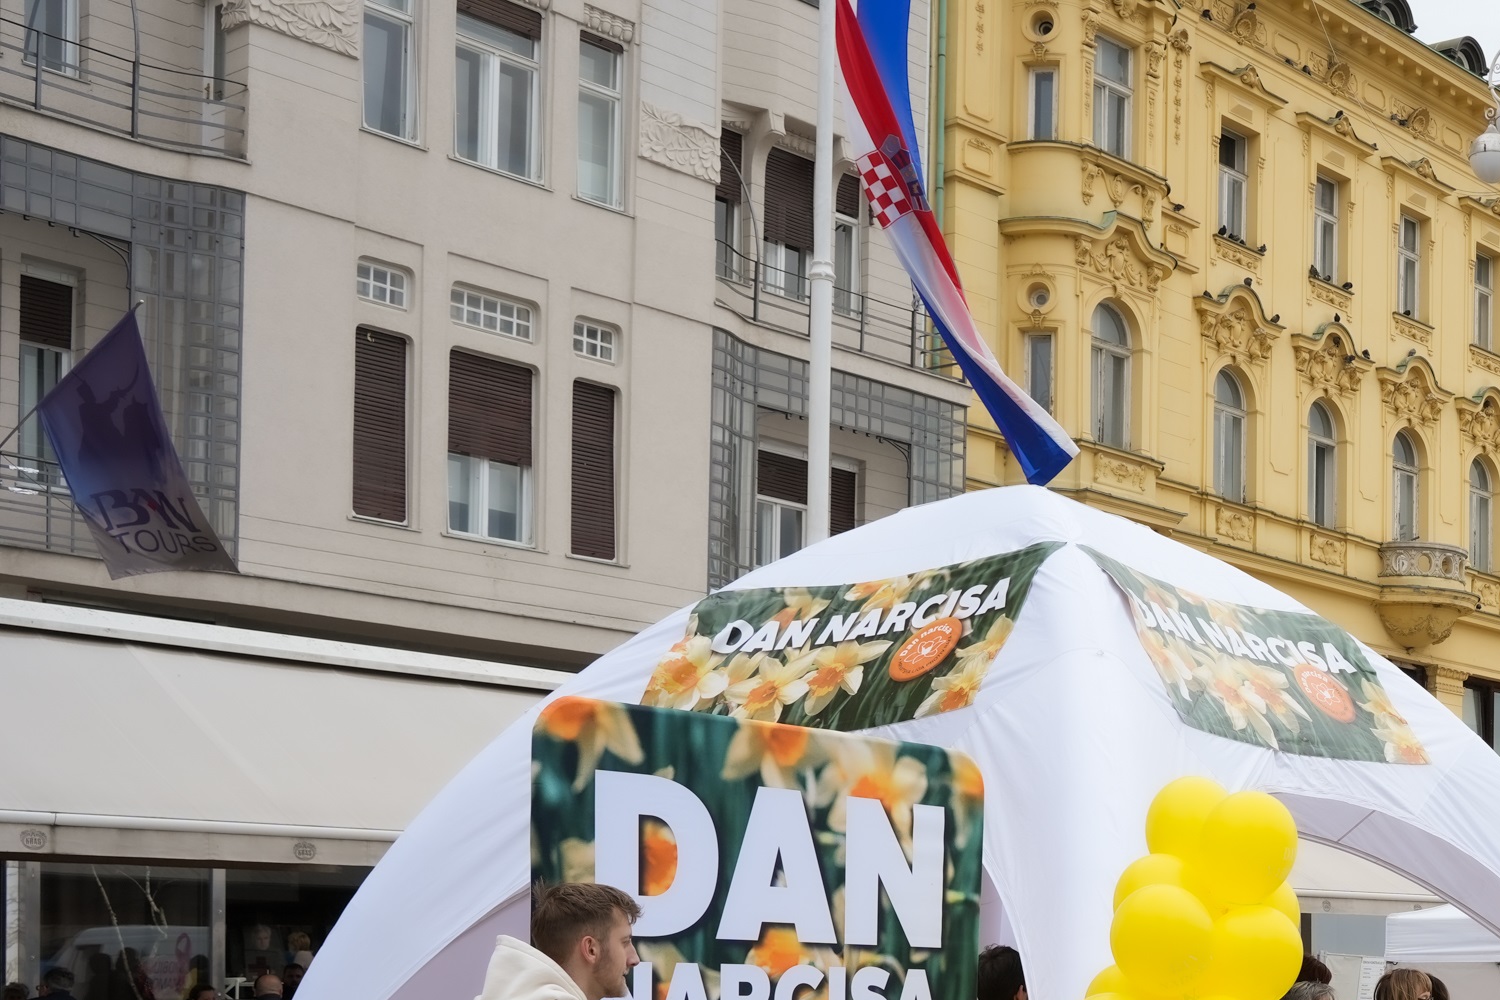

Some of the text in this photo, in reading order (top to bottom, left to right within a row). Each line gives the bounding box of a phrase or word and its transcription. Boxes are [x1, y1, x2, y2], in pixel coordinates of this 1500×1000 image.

[90, 488, 201, 532] BAN
[110, 529, 217, 554] TOURS
[711, 577, 1011, 654] DAN NARCISA
[1132, 596, 1357, 674] DAN NARCISA
[899, 638, 919, 657] Dan
[595, 769, 945, 949] DAN
